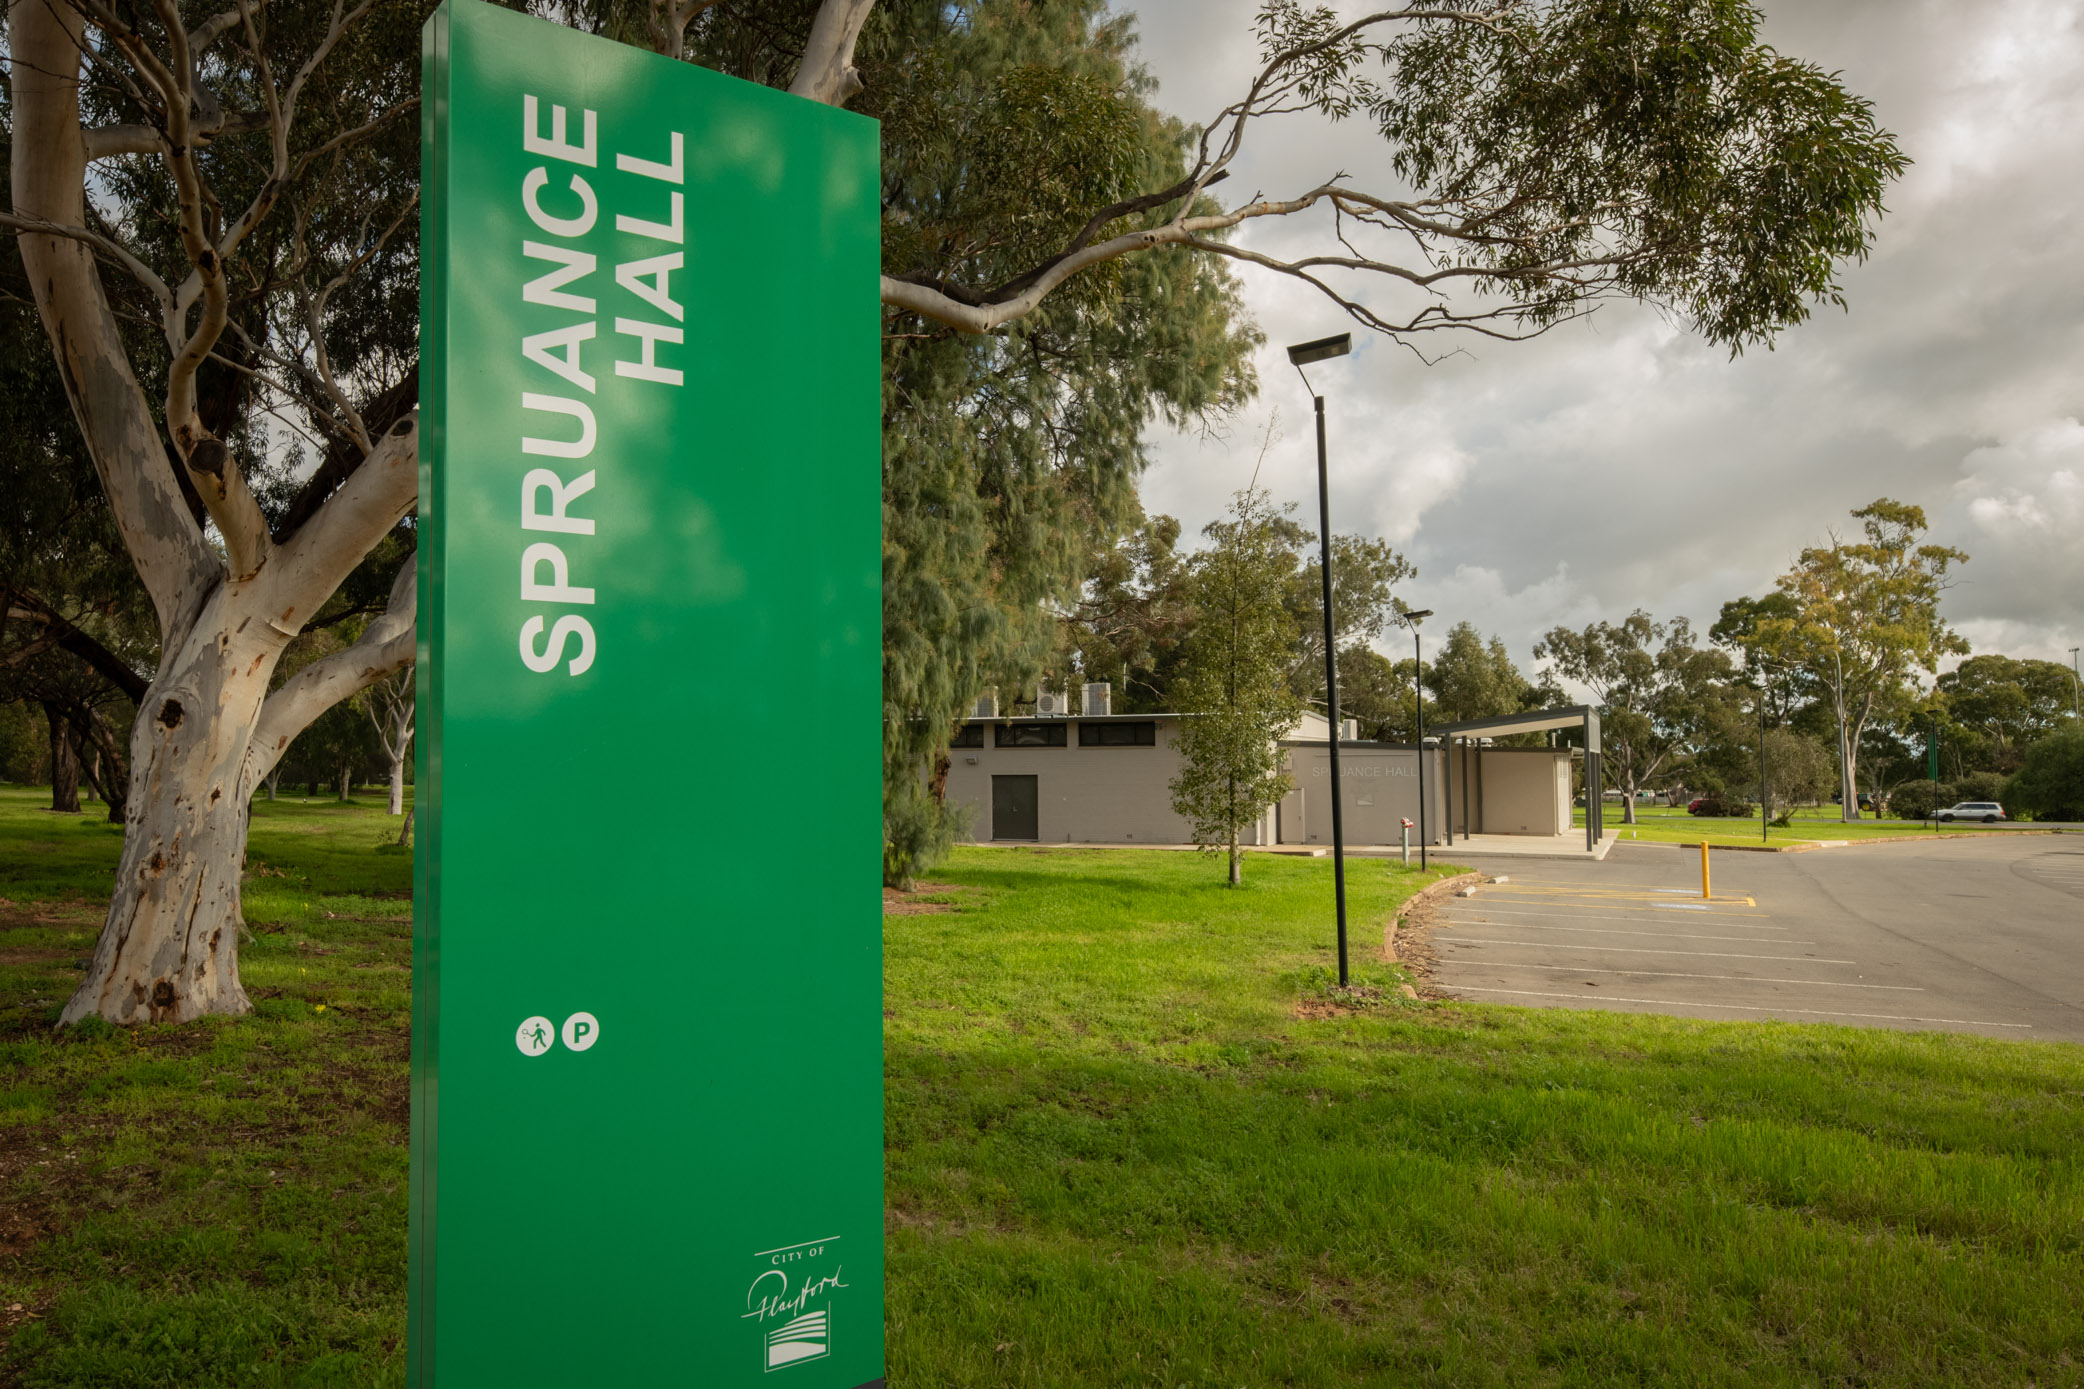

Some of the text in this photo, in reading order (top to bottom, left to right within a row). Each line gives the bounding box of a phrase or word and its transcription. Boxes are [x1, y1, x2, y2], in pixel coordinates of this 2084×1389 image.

[614, 131, 684, 386] HALL
[519, 94, 598, 676] SPRUANCE
[1312, 766, 1418, 777] SPUANCE HALL
[574, 1021, 591, 1044] P
[771, 1246, 825, 1265] CITY OF
[740, 1264, 850, 1323] Playford
